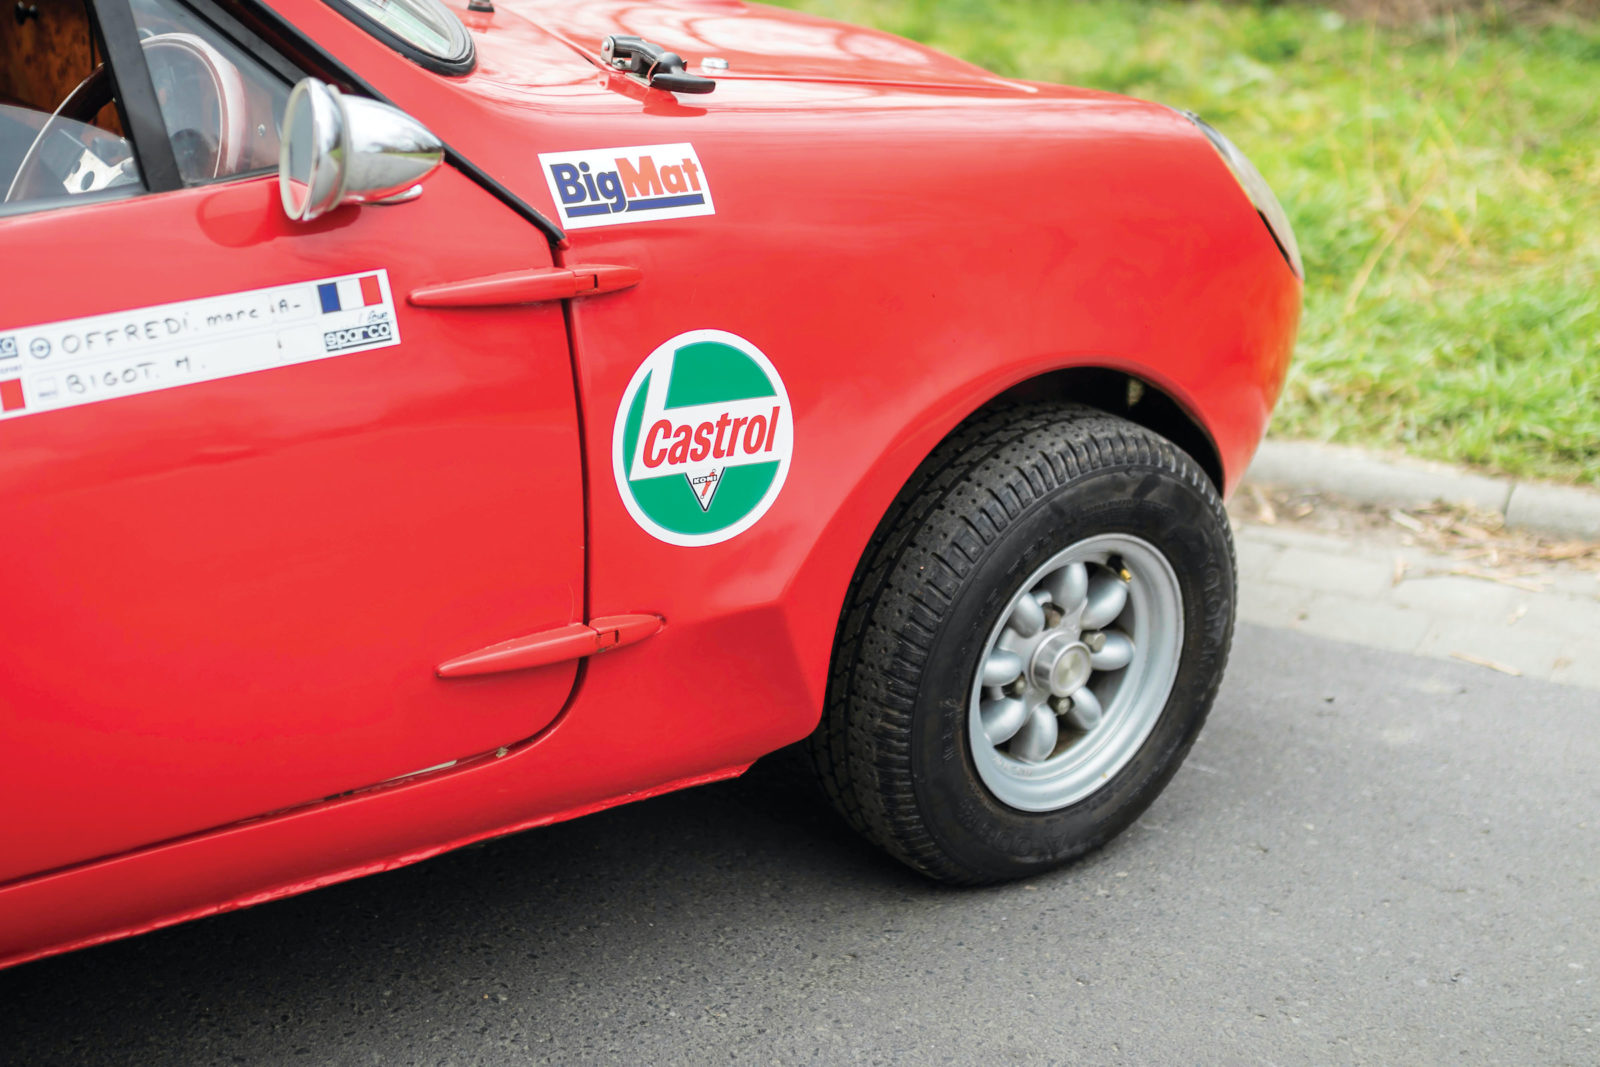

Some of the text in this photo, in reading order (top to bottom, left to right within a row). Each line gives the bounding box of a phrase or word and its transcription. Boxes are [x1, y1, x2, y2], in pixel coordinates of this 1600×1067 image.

[550, 155, 702, 213] BigMat
[324, 322, 392, 352] sparco
[643, 405, 780, 468] Castrol
[693, 475, 717, 485] KONI
